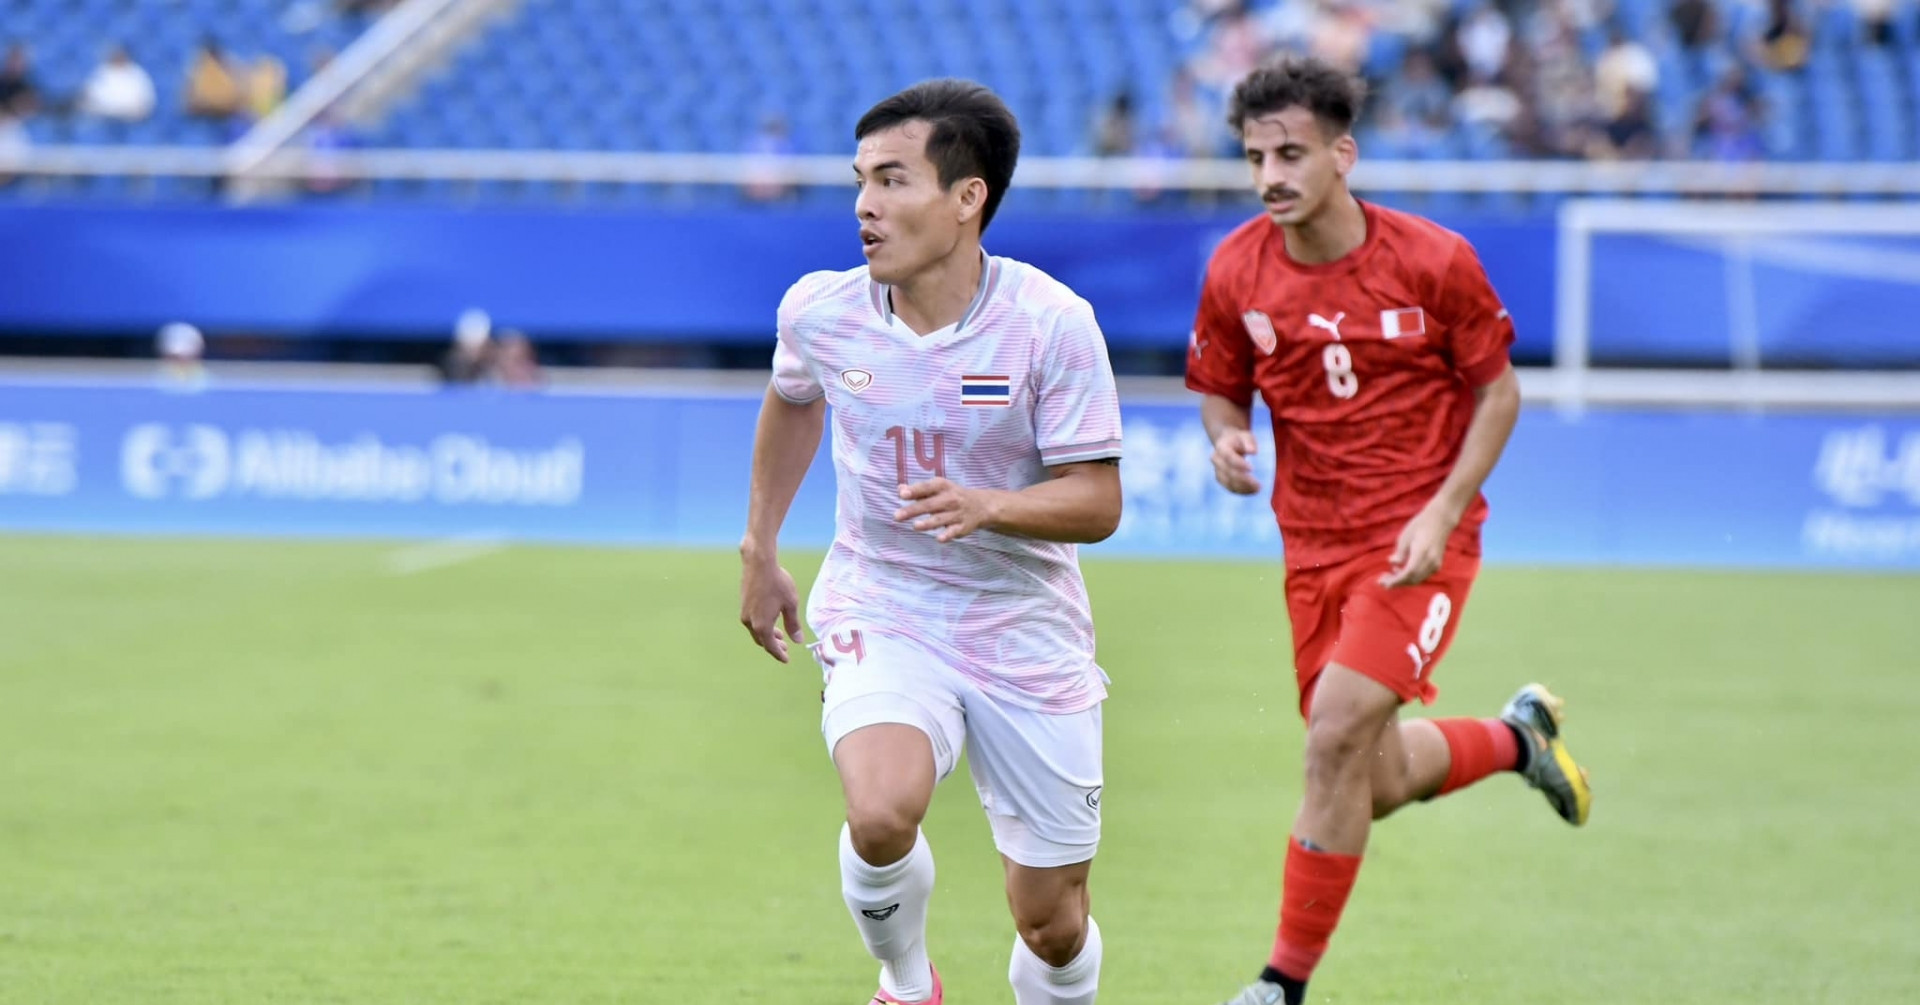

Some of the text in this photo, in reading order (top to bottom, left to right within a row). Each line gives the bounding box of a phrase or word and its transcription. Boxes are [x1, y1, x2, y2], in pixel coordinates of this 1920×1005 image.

[1322, 343, 1358, 400] 8
[432, 433, 583, 503] Cloud
[885, 425, 946, 485] 14
[1418, 592, 1452, 654] 8
